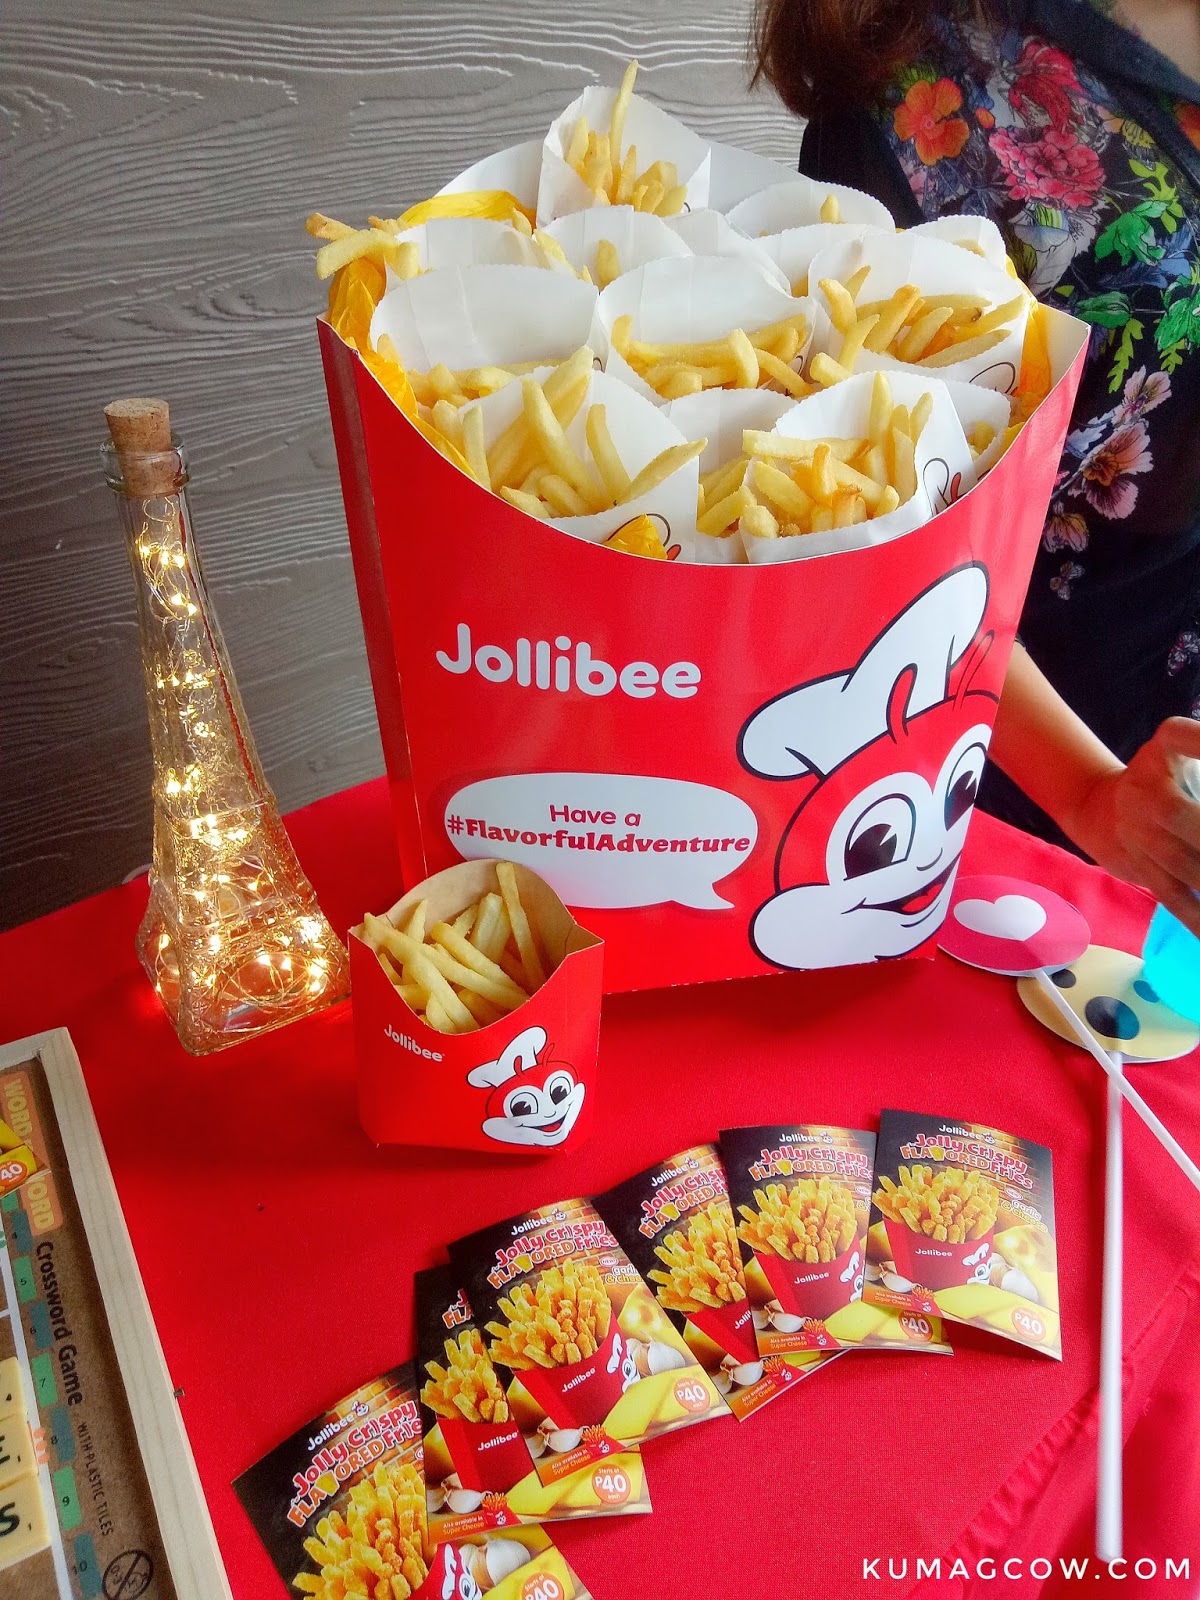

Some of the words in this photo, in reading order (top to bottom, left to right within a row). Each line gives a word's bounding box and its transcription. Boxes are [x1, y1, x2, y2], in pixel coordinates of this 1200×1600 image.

[435, 622, 702, 699] Jollibee
[549, 804, 617, 826] Have
[624, 811, 642, 827] a
[446, 813, 751, 853] #FlavorfulAdventure
[384, 1024, 443, 1062] Jollibee
[779, 1133, 820, 1143] Jollibee
[938, 1124, 982, 1141] Jollibee
[761, 1145, 807, 1165] Jolly
[810, 1147, 867, 1167] Crispy
[914, 1134, 964, 1153] Jolly
[967, 1143, 1027, 1175] Crispy
[651, 1165, 688, 1187] Jollibee
[990, 1162, 1033, 1189] Fries
[27, 1175, 54, 1230] ORD
[640, 1183, 686, 1218] Jolly
[684, 1167, 727, 1190] Crisp
[511, 1216, 553, 1236] Jollibee
[495, 1235, 543, 1268] Jolly
[545, 1220, 605, 1243] Crispy
[574, 1234, 619, 1250] Fries
[915, 1248, 953, 1257] Jollibee
[794, 1272, 829, 1284] Jollibee
[36, 1241, 73, 1341] Crossword
[58, 1343, 83, 1407] Game
[562, 1367, 596, 1392] Jollibee
[307, 1413, 355, 1451] Jollibee
[381, 1418, 423, 1449] Frie
[478, 1432, 518, 1451] Jollibee
[292, 1441, 349, 1497] Jolly
[347, 1400, 418, 1448] Crispy
[77, 1421, 93, 1451] WITH
[85, 1451, 105, 1501] PLASTIC
[97, 1501, 114, 1537] TILES
[595, 1474, 627, 1493] P40
